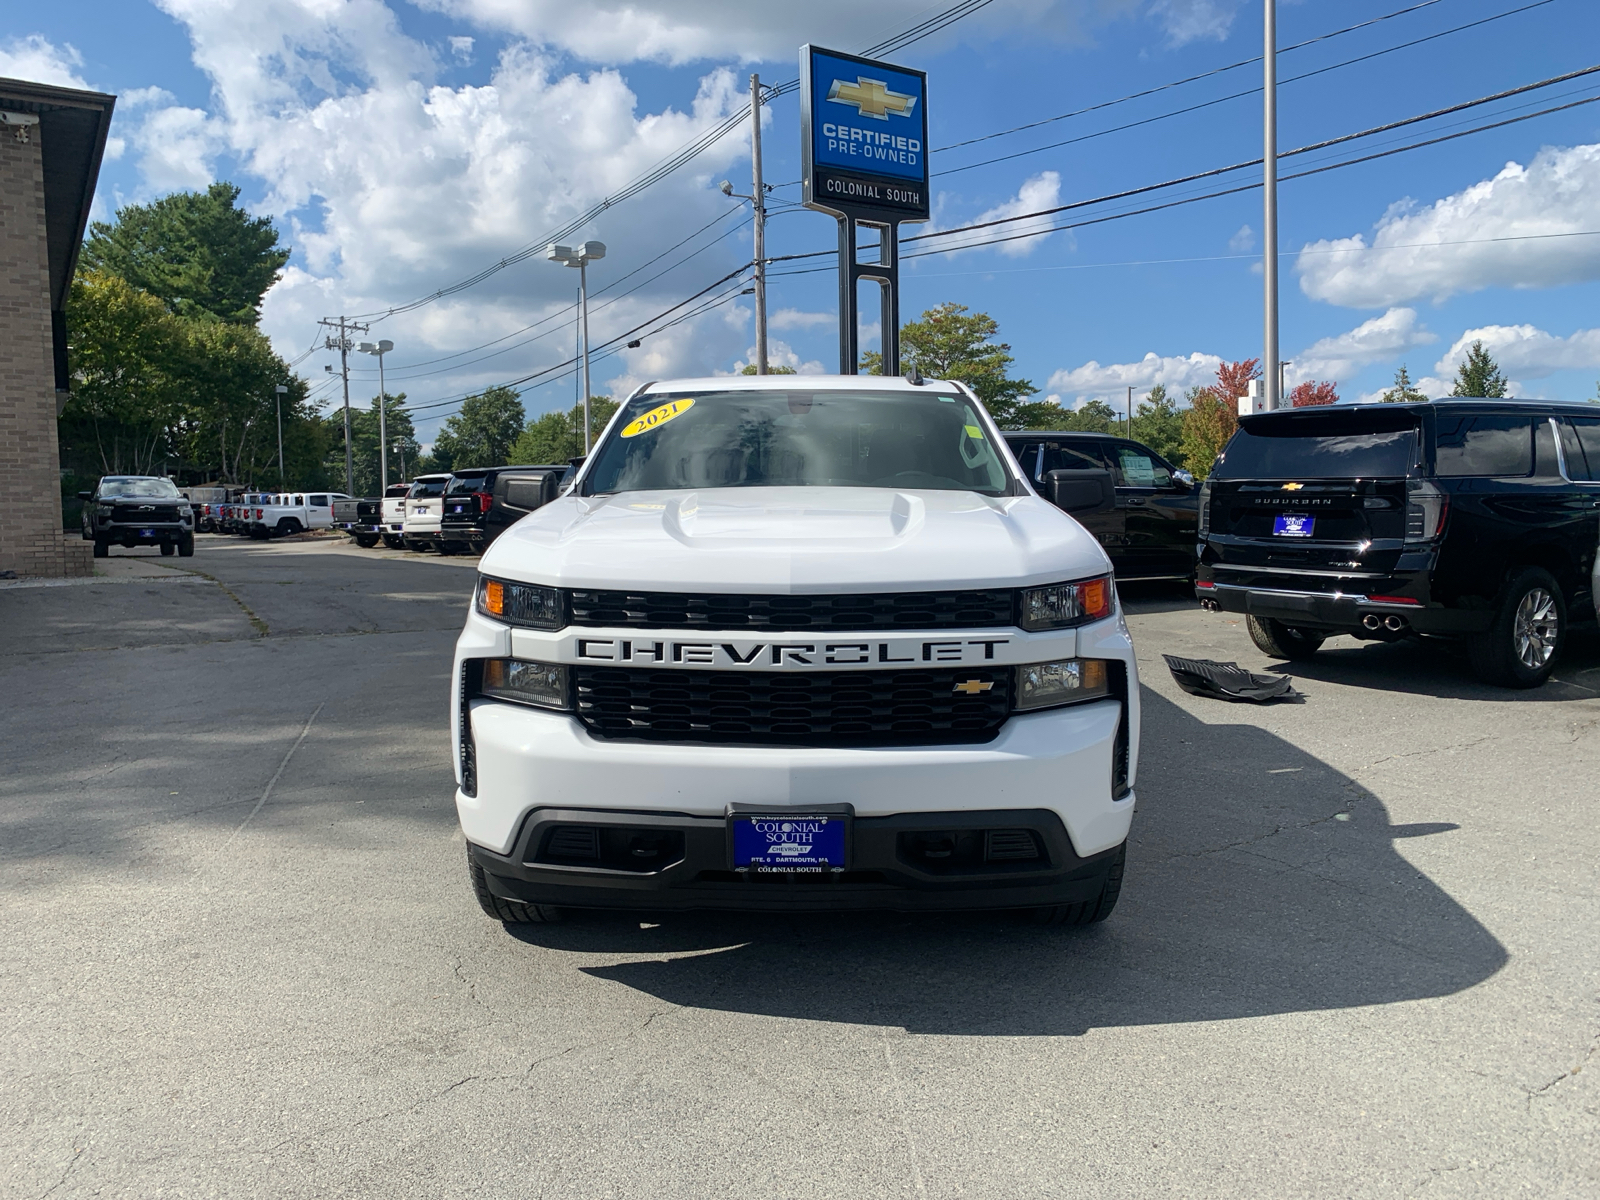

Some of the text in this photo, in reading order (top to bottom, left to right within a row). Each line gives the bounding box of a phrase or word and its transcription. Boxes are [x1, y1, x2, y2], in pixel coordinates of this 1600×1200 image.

[823, 123, 921, 152] CERTIFIED
[828, 139, 917, 165] PRE-OWNED
[827, 179, 920, 204] COLONIAL SOUTH
[635, 403, 678, 432] 2021
[577, 639, 1010, 665] CHEVROLET
[755, 822, 824, 833] COLONIAL
[766, 832, 813, 843] SOUTH
